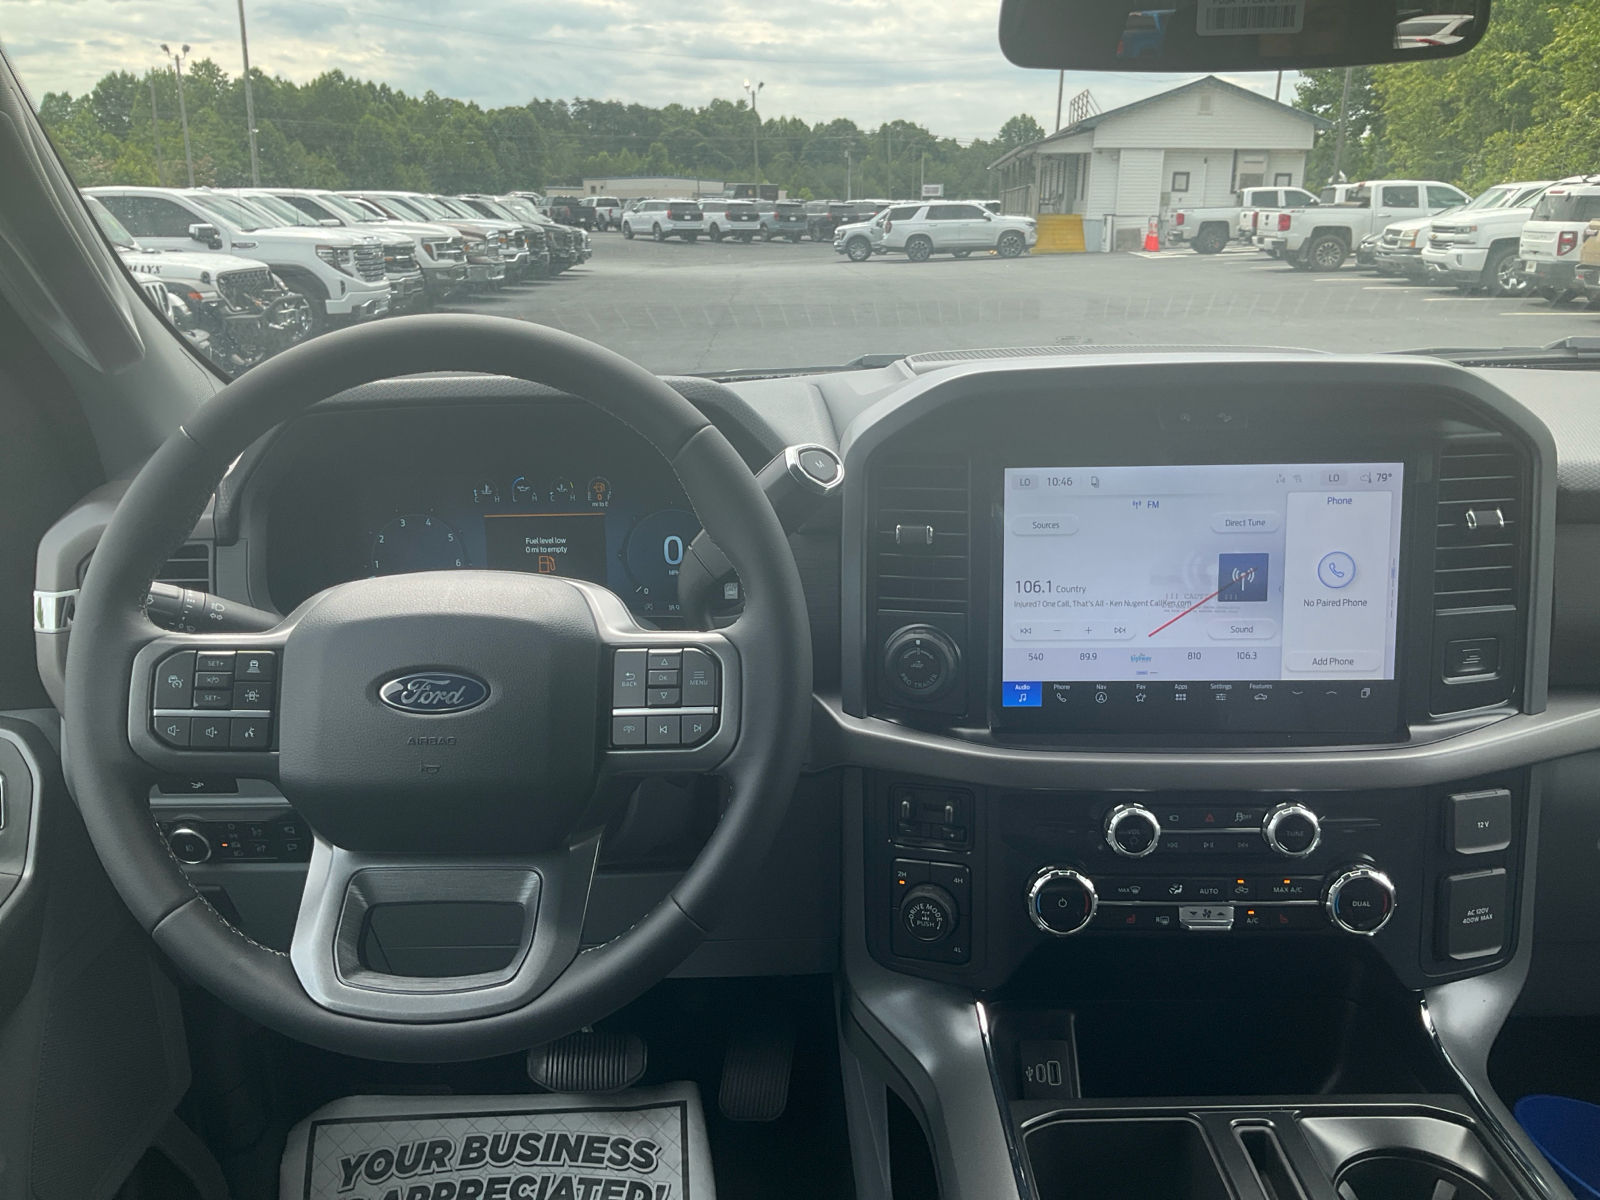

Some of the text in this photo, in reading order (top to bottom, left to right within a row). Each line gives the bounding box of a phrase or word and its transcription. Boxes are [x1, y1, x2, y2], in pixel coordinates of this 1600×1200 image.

[1047, 477, 1073, 486] 10:46
[1328, 474, 1340, 482] LO
[1376, 473, 1392, 482] 79°
[1020, 478, 1030, 486] LO
[1327, 497, 1352, 505] Phone
[400, 519, 405, 527] 3
[1225, 519, 1246, 527] Direct
[379, 535, 384, 543] 2
[664, 536, 683, 565] 0
[1015, 580, 1086, 594] 106.1 Country
[1230, 626, 1253, 634] Sound
[1028, 653, 1044, 661] 540
[1080, 653, 1098, 661] 89.9
[1187, 652, 1201, 660] 810
[1236, 652, 1257, 660] 106.3
[901, 673, 938, 688] PRO TRAILER
[401, 679, 466, 704] Ford
[407, 736, 456, 745] AIRBAG
[909, 903, 942, 922] DRIVE MODE
[338, 1132, 659, 1190] YOUR BUSINESS
